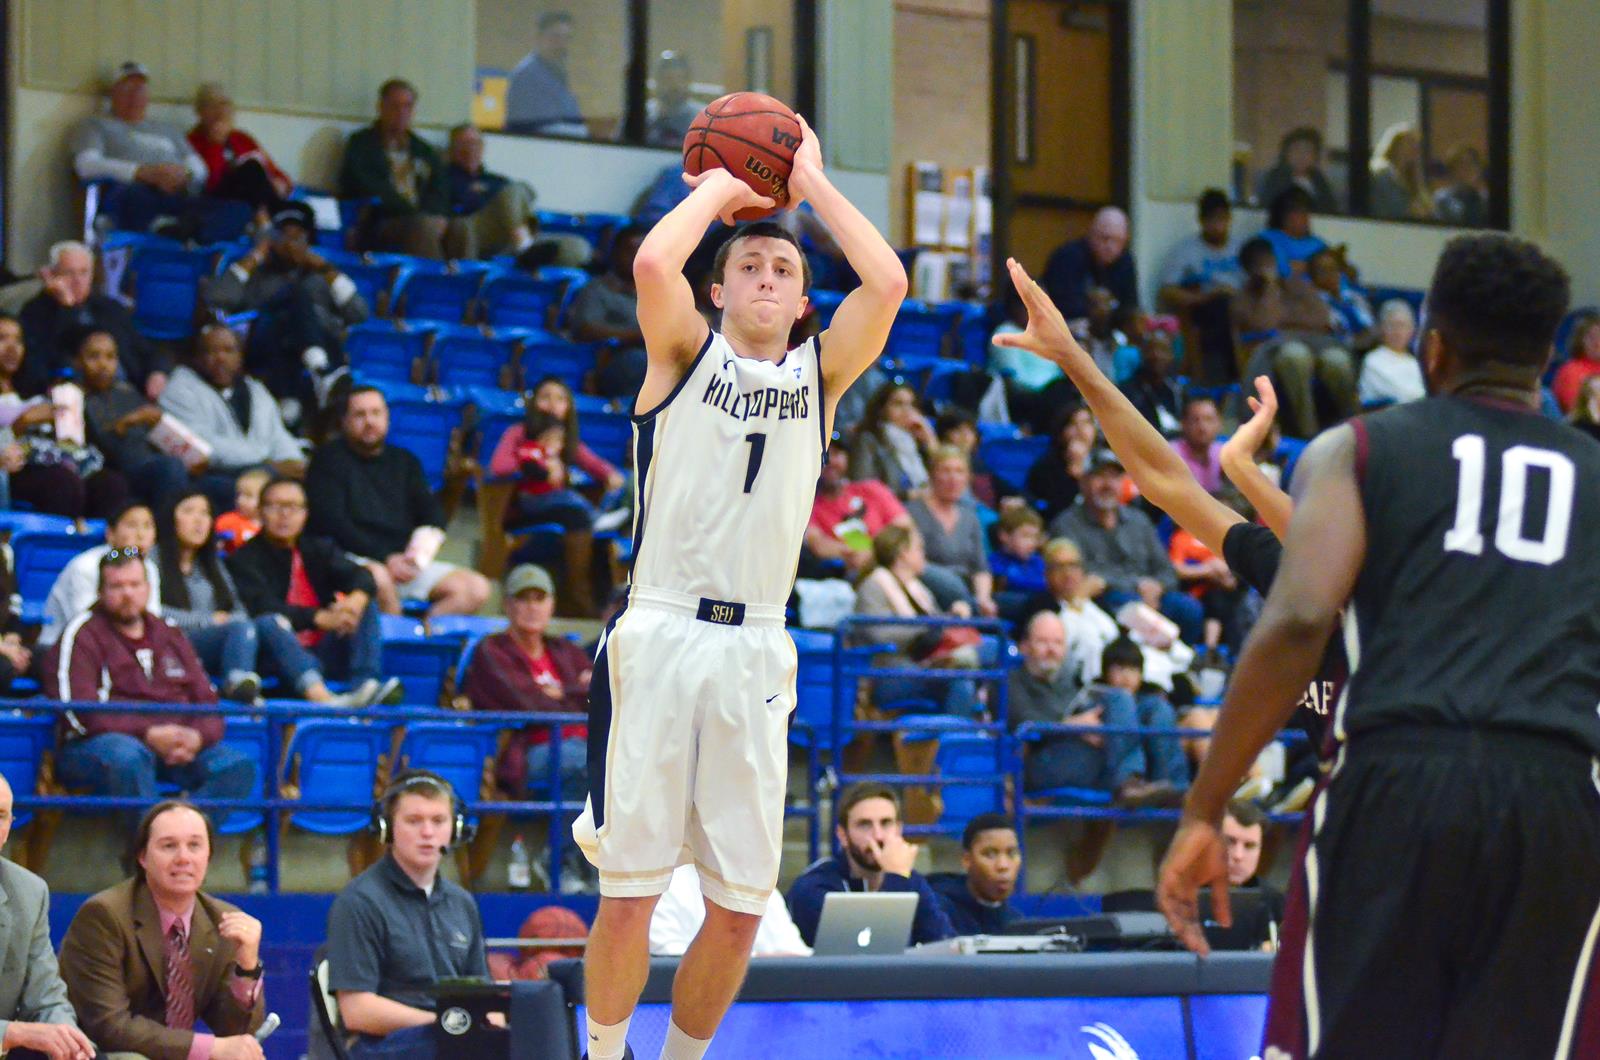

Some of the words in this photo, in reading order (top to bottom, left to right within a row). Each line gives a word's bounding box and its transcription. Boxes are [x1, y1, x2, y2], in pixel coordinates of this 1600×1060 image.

[743, 432, 766, 493] 1
[1444, 433, 1576, 565] 10
[711, 604, 733, 623] SEU
